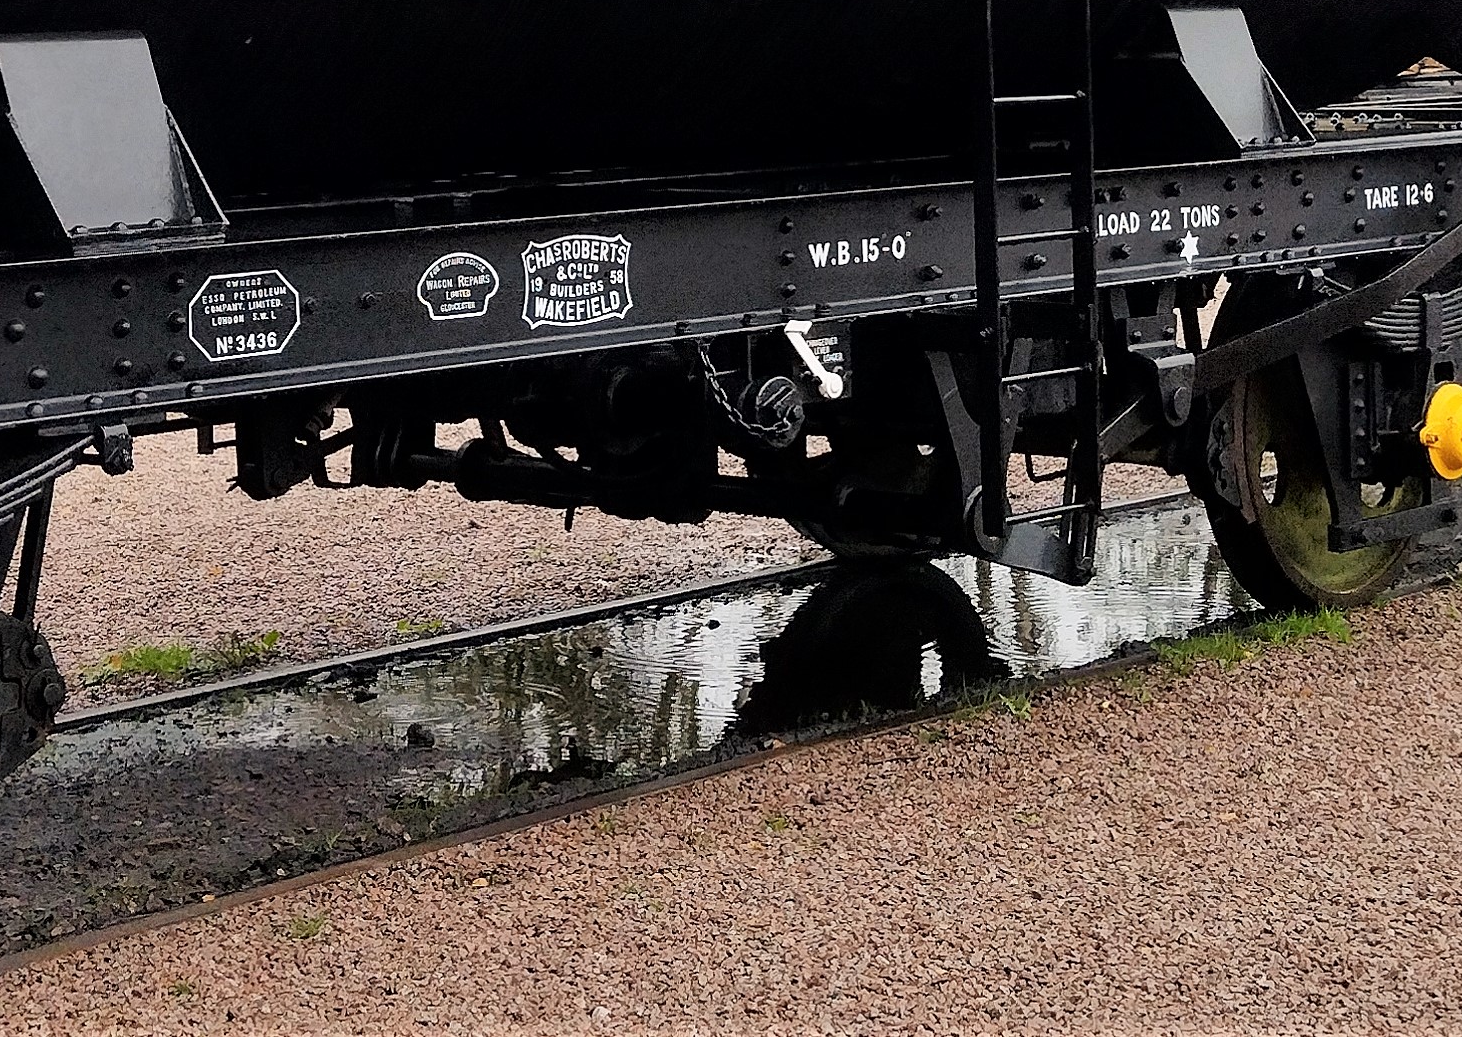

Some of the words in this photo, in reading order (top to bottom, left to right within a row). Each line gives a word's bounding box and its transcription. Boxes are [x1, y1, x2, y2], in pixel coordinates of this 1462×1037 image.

[1364, 185, 1398, 210] TARE
[1098, 211, 1140, 237] LOAD
[1150, 209, 1172, 232] 22
[1180, 204, 1220, 229] TONS
[562, 240, 627, 264] ROBERTS
[531, 277, 543, 292] 19
[610, 270, 623, 284] 58
[202, 294, 225, 305] ESSO
[233, 286, 287, 301] PETROLEUM
[550, 280, 604, 297] BUILDERS
[535, 290, 620, 321] WAKEFIELD
[235, 331, 277, 352] 3436
